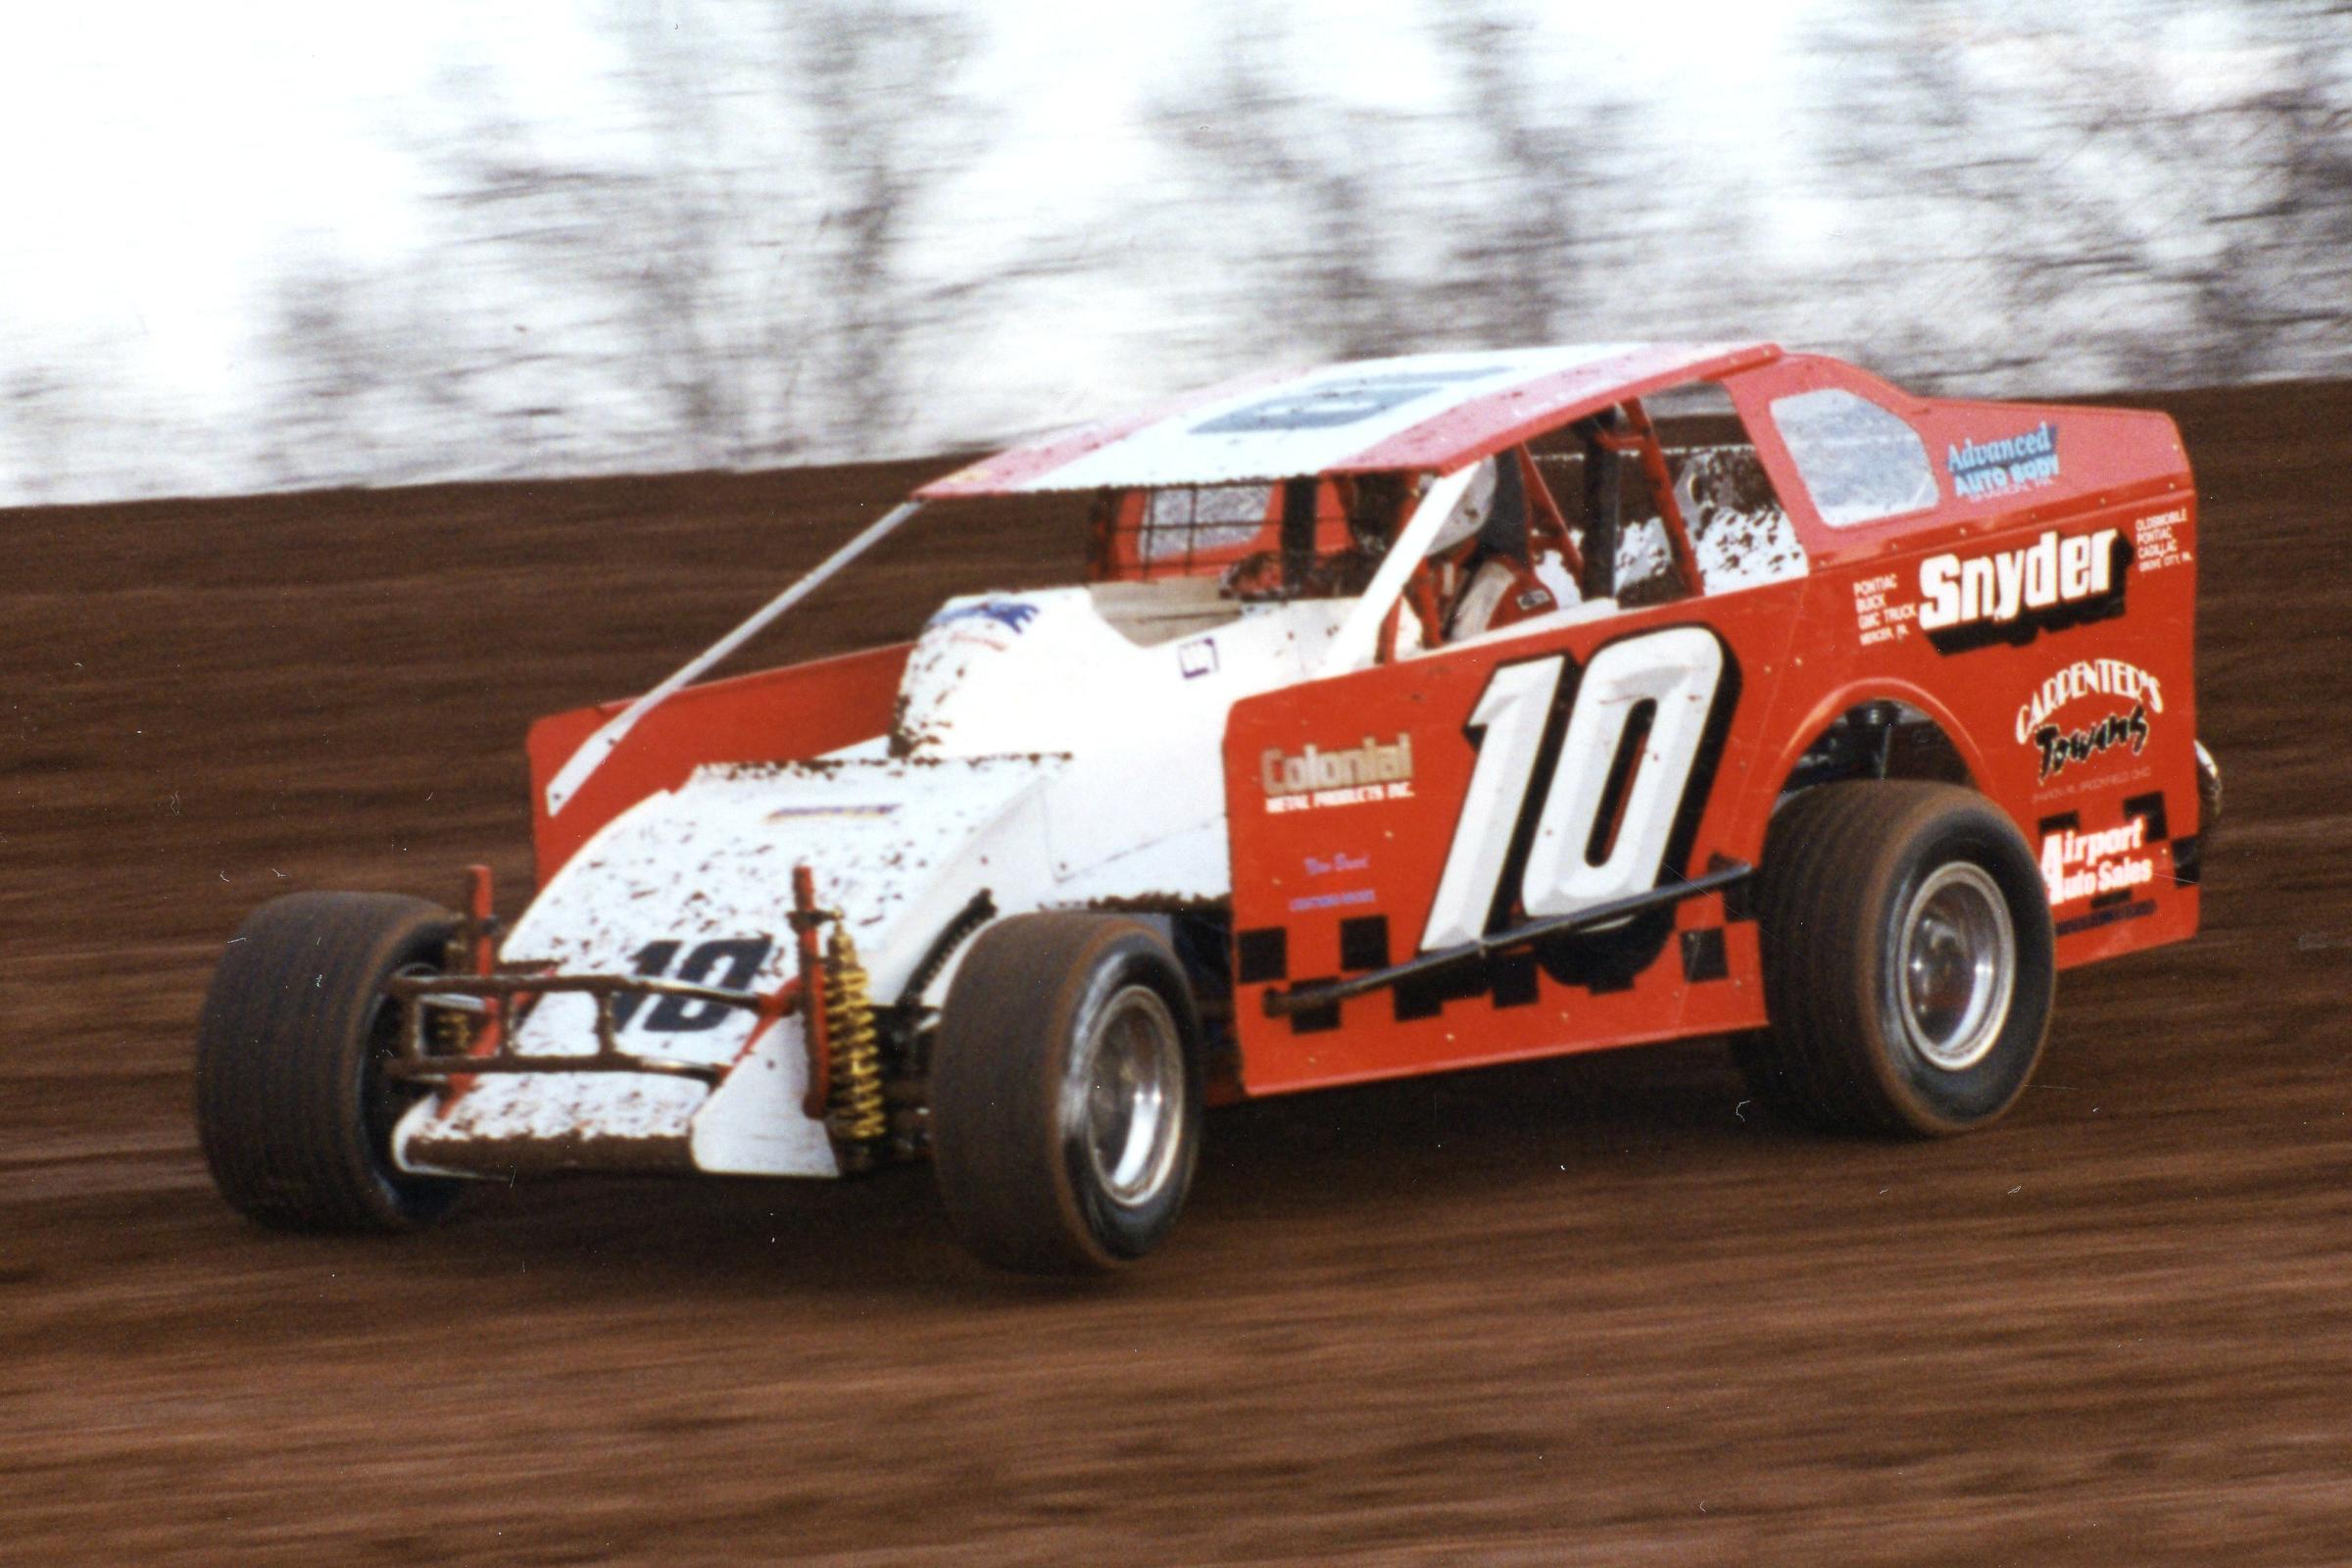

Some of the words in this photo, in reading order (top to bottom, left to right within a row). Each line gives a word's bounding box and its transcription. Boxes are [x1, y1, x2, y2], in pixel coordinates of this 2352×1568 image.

[1946, 420, 2054, 472] Advanced
[1955, 466, 2009, 497] AUTO
[2010, 454, 2059, 484] BODY
[1884, 602, 1917, 623] TRUCK
[1918, 527, 2119, 631] Snyder
[2016, 658, 2164, 745] CARPENTER'S
[1260, 732, 1414, 799] Colonial
[1419, 625, 1726, 952] 10
[2040, 814, 2144, 887] Airport
[2098, 856, 2153, 892] Sales
[610, 938, 772, 1033] 10
